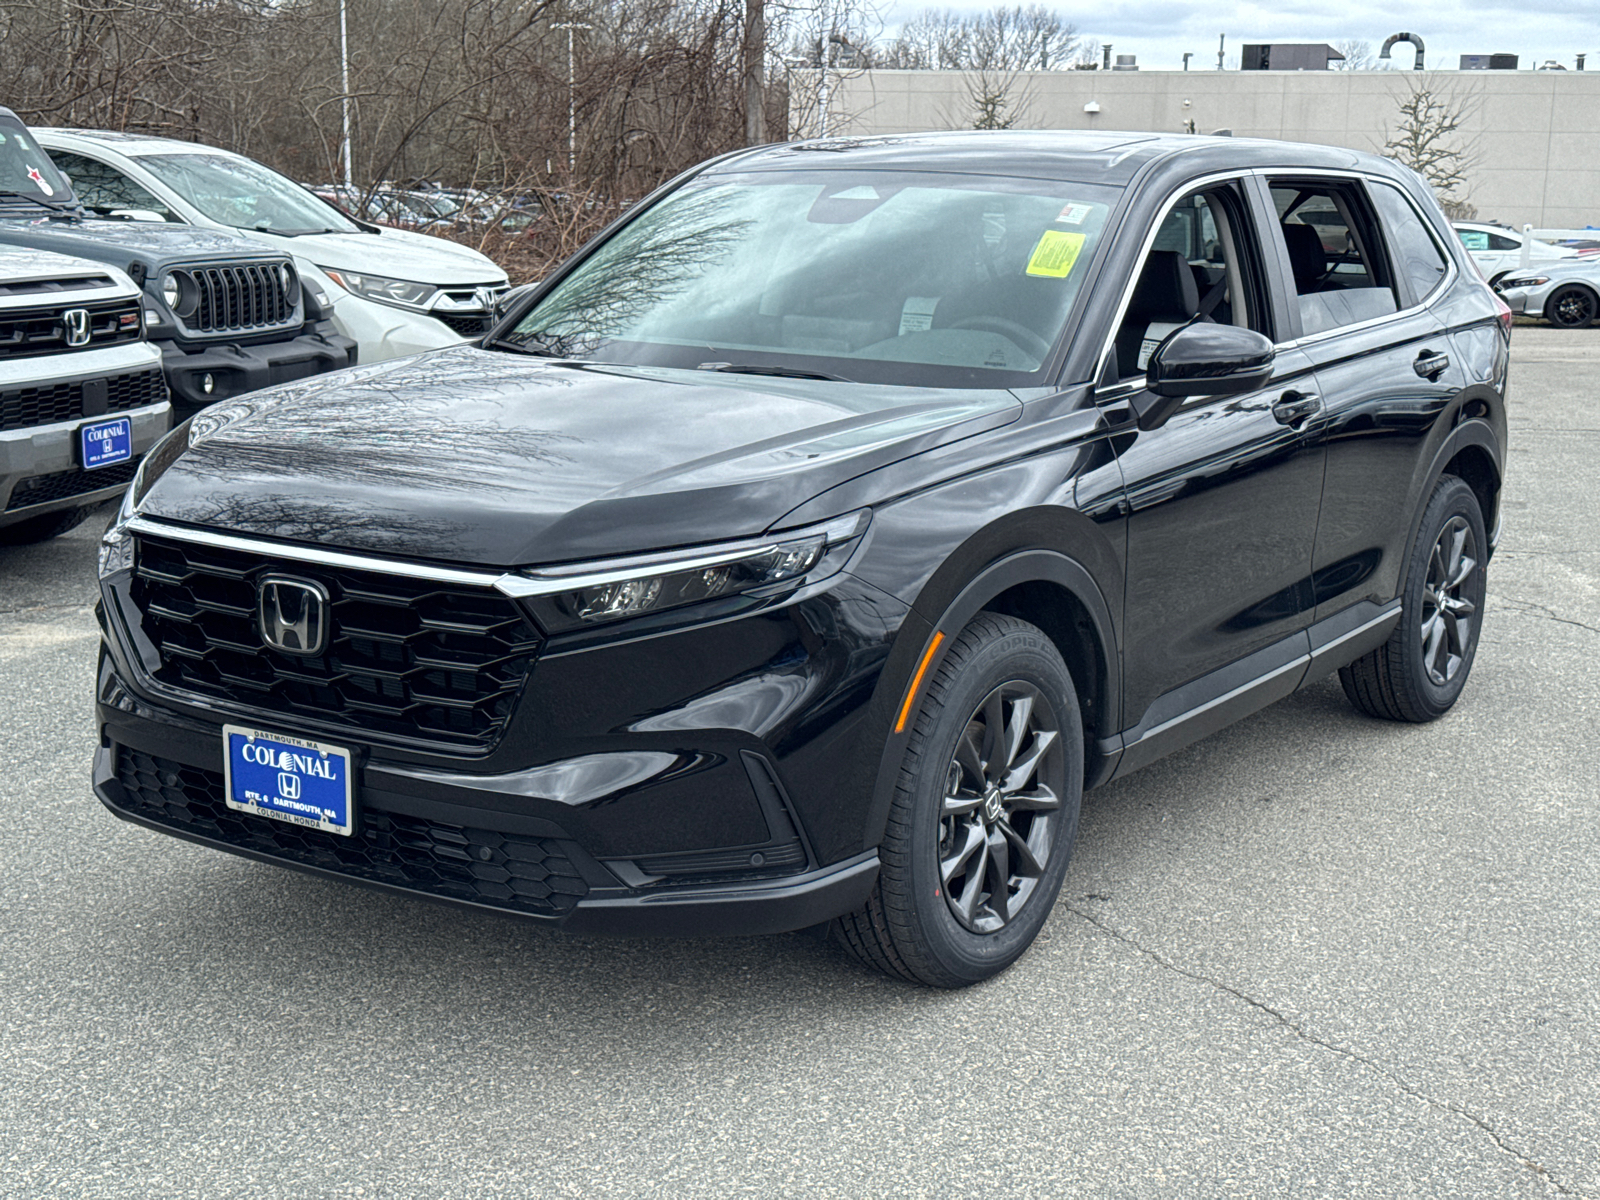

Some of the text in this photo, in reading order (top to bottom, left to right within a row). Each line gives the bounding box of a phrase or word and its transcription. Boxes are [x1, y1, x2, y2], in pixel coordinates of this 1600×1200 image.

[88, 426, 125, 442] COLONIAL
[306, 741, 318, 749] MA
[242, 743, 336, 780] COLONIAL
[245, 790, 262, 801] RTE.
[274, 798, 323, 815] DARTMOUTH,
[324, 808, 337, 819] MA
[256, 808, 321, 829] COLONIAL HONDA
